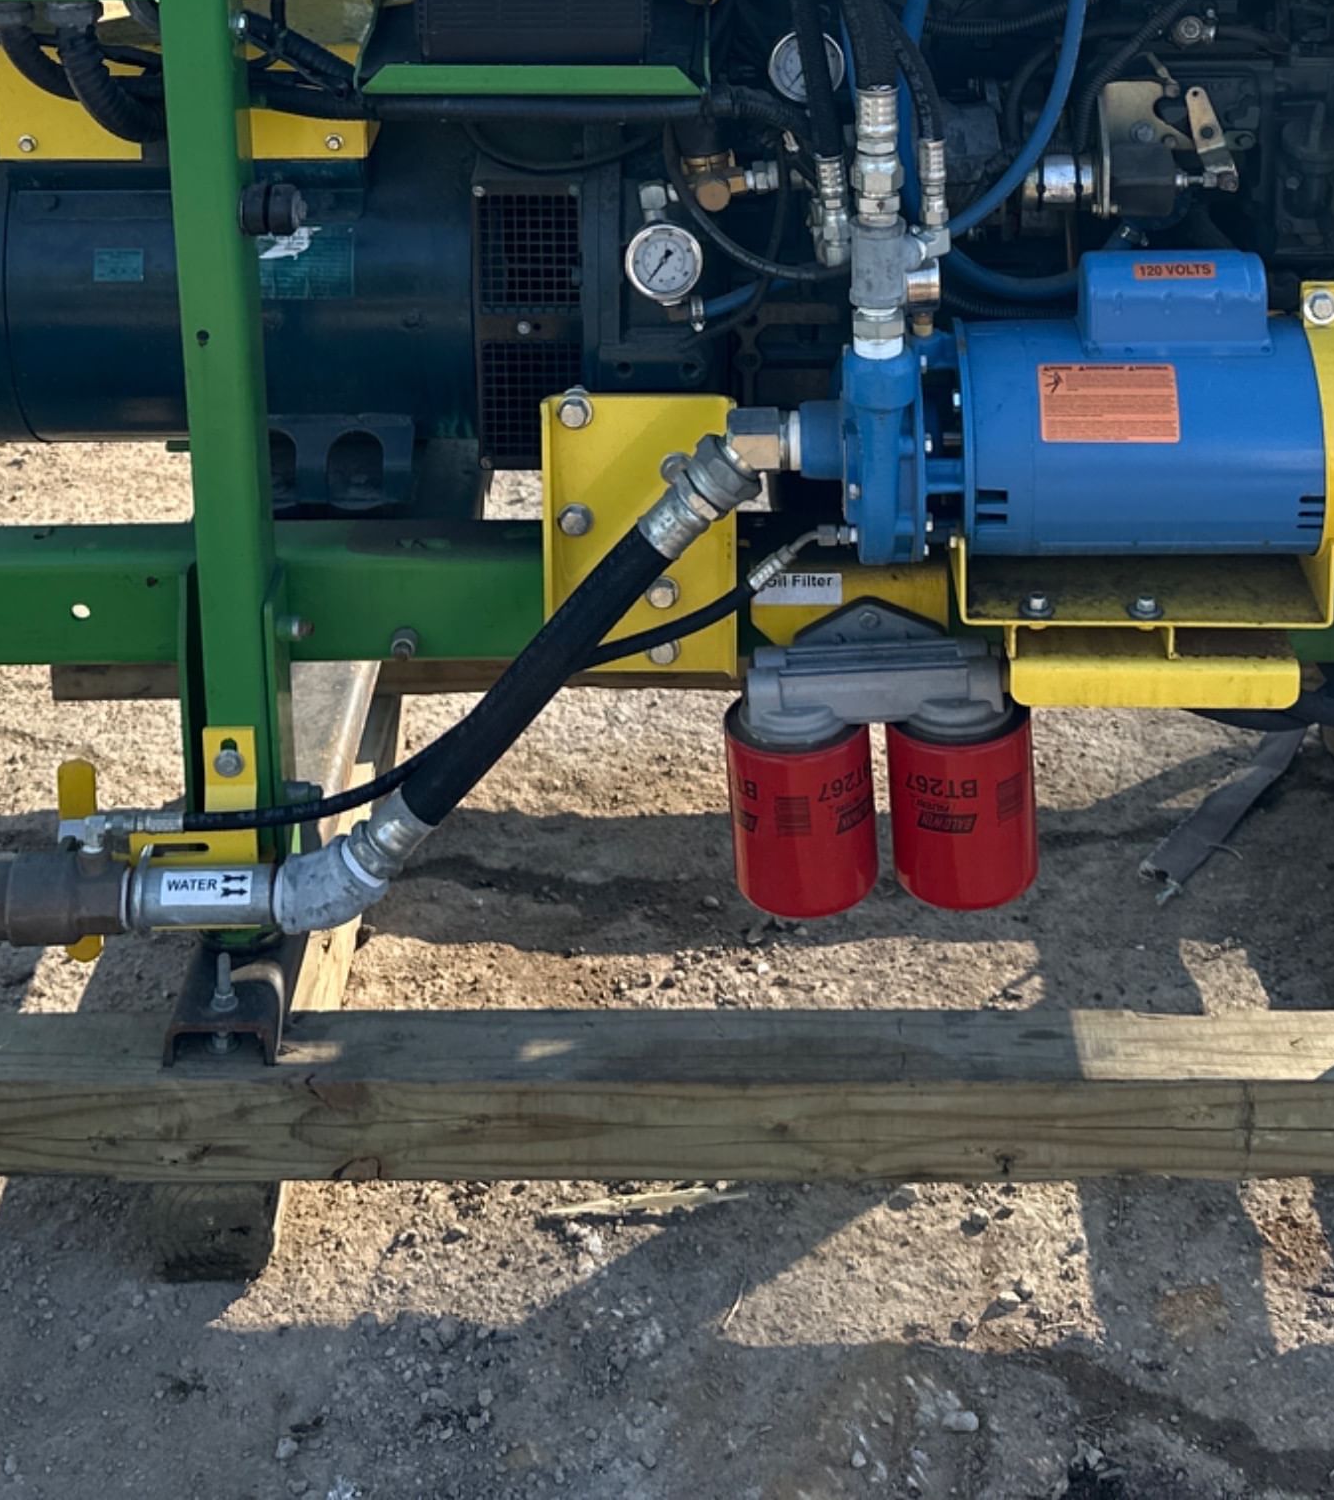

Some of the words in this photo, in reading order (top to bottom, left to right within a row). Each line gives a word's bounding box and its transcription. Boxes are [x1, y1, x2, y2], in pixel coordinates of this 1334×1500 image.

[1140, 265, 1162, 277] 120
[1166, 264, 1212, 276] VOLTS
[792, 574, 833, 587] Filter
[905, 772, 978, 798] BT267
[920, 813, 975, 832] BALDWIN
[167, 879, 218, 892] WATER
